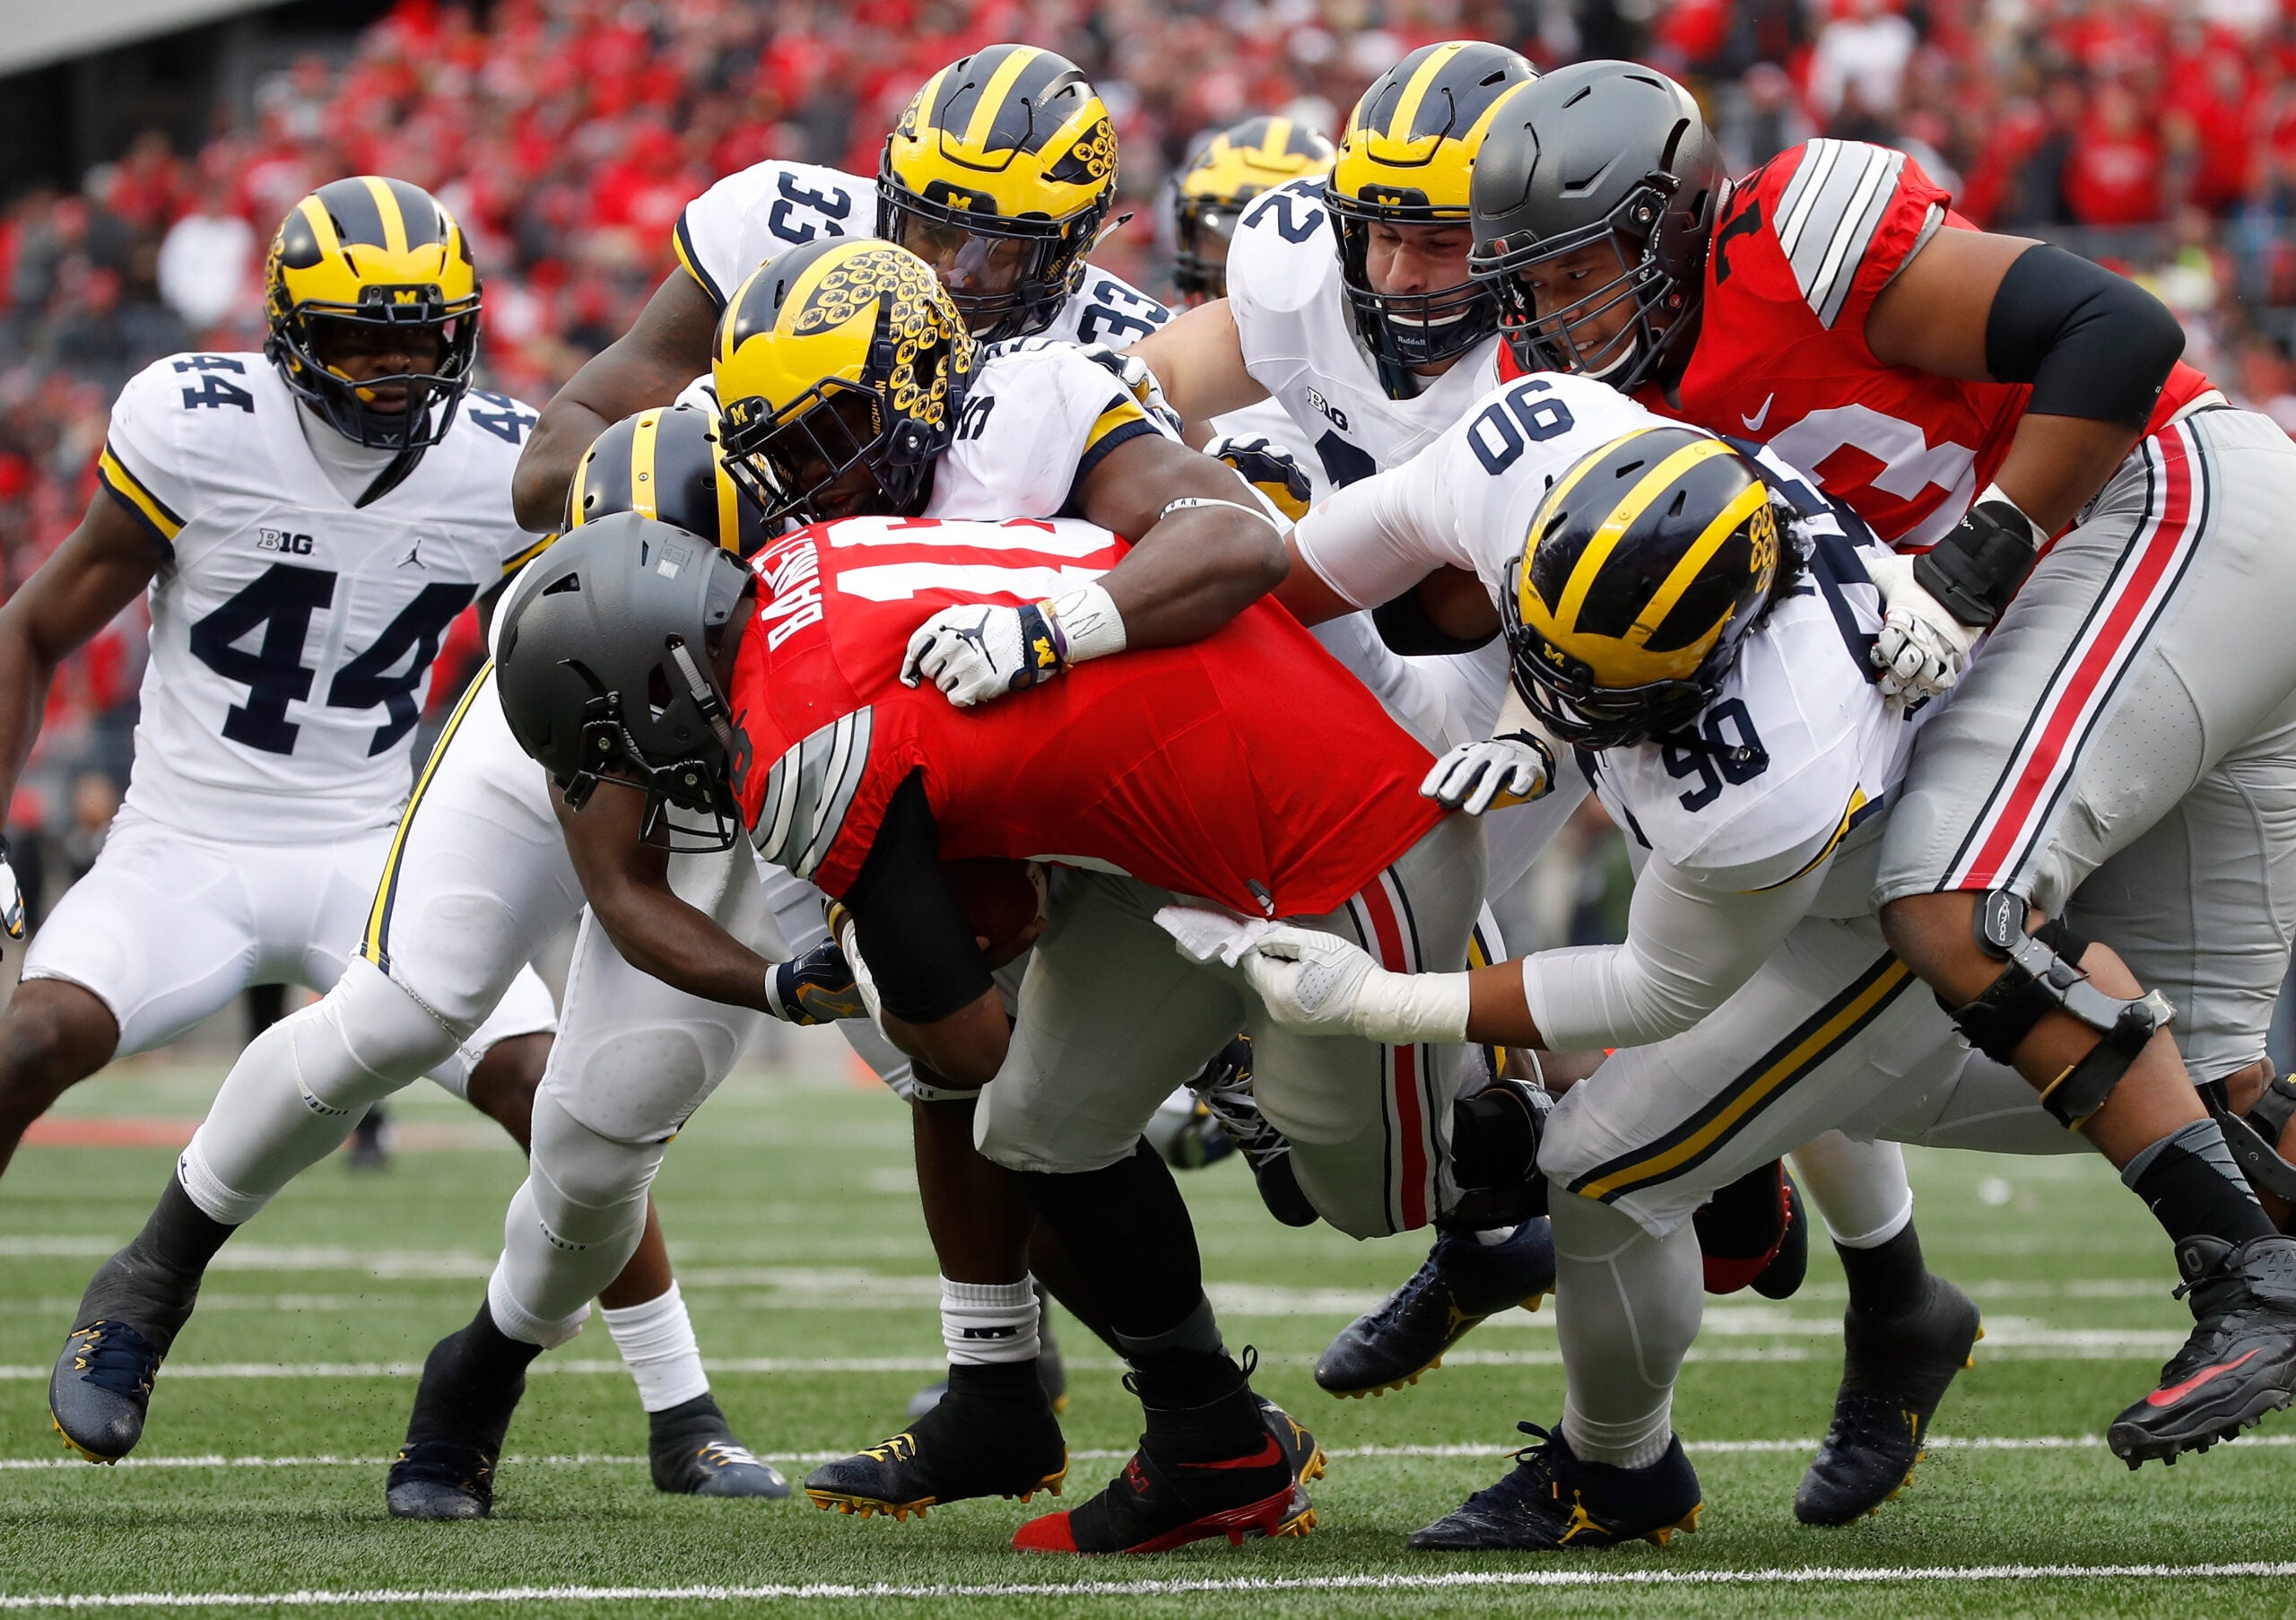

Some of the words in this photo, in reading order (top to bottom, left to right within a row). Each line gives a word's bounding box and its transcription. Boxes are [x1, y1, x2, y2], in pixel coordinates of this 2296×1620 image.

[769, 171, 851, 245] 33
[946, 192, 972, 211] M
[1378, 195, 1401, 215] M
[394, 291, 418, 304] M
[1077, 280, 1171, 344] 33
[1397, 335, 1426, 346] Riddell
[172, 355, 255, 414] 44
[730, 403, 749, 426] M
[1467, 379, 1574, 476] 90
[189, 562, 480, 757] 44
[1032, 636, 1057, 669] M
[1544, 641, 1565, 668] M
[1661, 697, 1770, 814] 90
